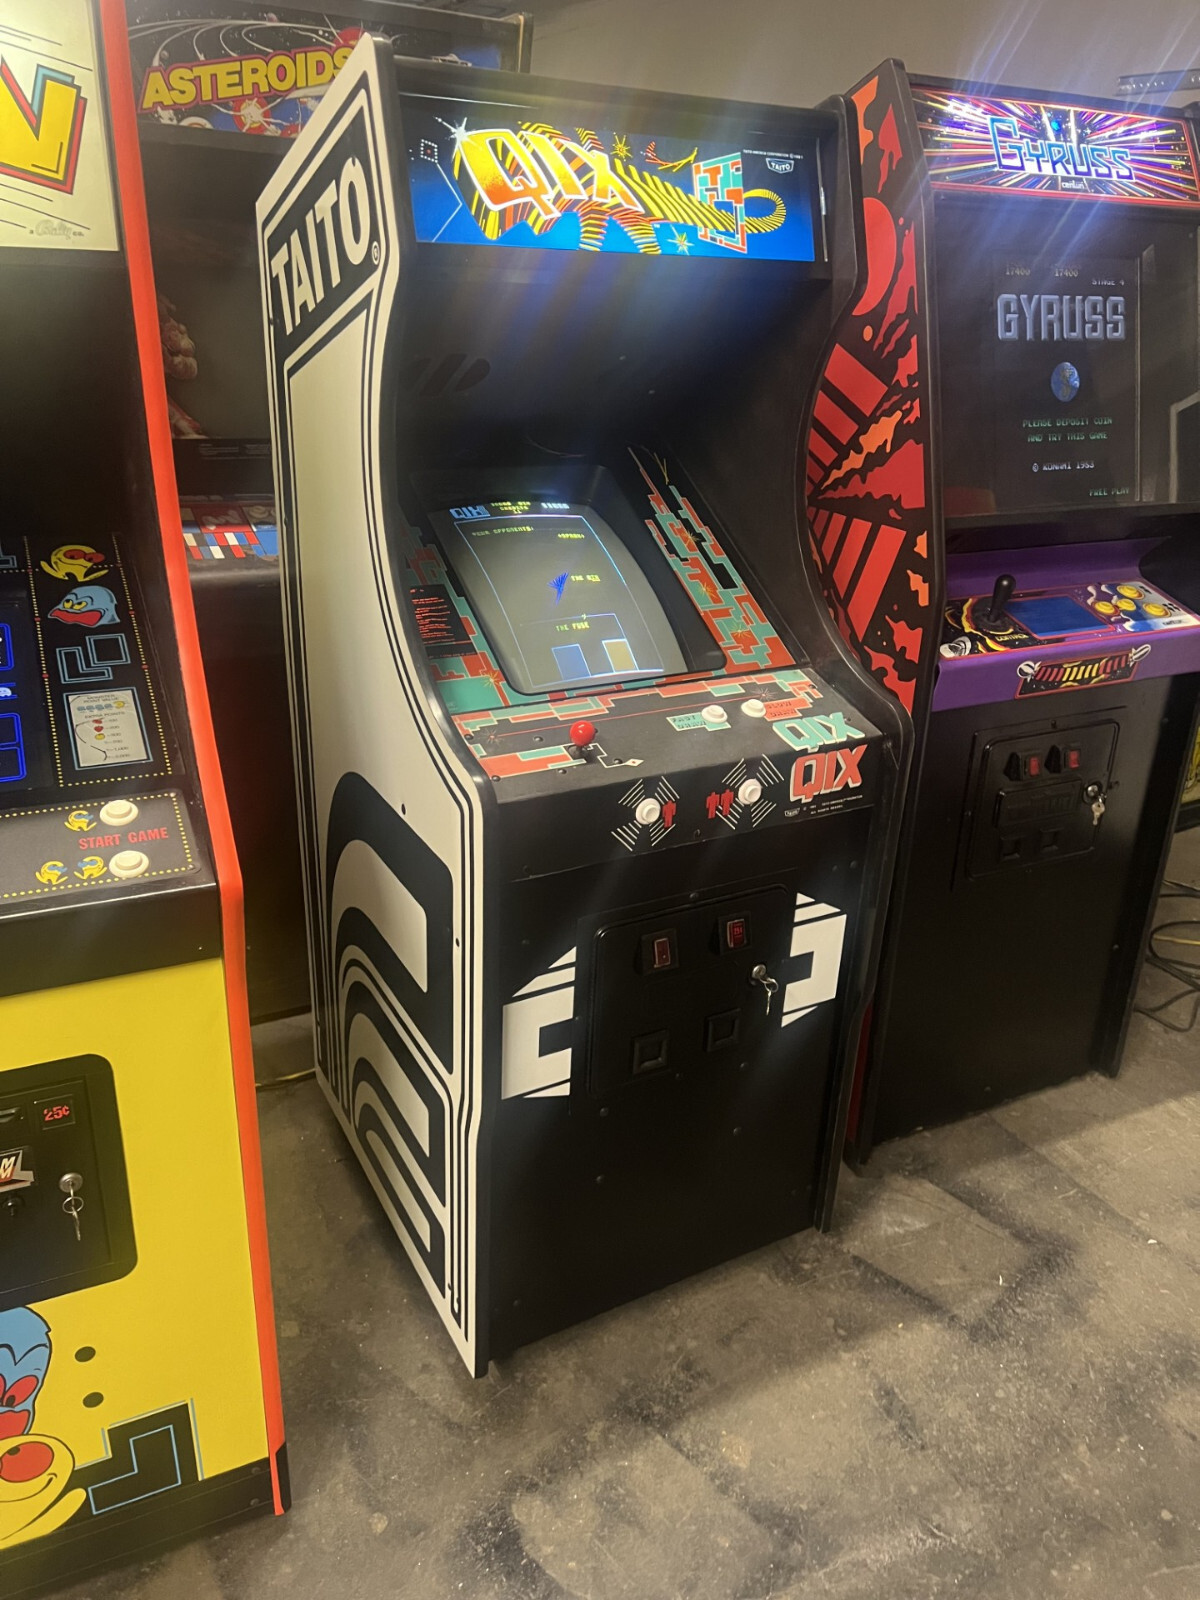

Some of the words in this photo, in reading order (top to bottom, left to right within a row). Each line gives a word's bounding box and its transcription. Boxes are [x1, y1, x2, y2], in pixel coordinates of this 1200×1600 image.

[140, 46, 355, 109] ASTEROIDS
[770, 162, 791, 171] TAITO
[989, 115, 1137, 183] GYRUSS
[455, 127, 646, 221] QIX
[270, 156, 371, 336] TAITO
[997, 294, 1126, 341] GYRUSS
[1022, 419, 1052, 428] PLEASE
[1056, 417, 1089, 427] DEPOSIT
[1094, 417, 1113, 425] COIN
[1027, 433, 1043, 442] AND
[1048, 433, 1062, 442] TRY
[1067, 432, 1085, 440] THIS
[1089, 431, 1108, 440] GAME
[772, 712, 866, 753] QIX
[790, 744, 869, 804] QIX
[78, 833, 120, 850] START
[127, 827, 169, 844] GAME
[43, 1105, 70, 1121] 25¢
